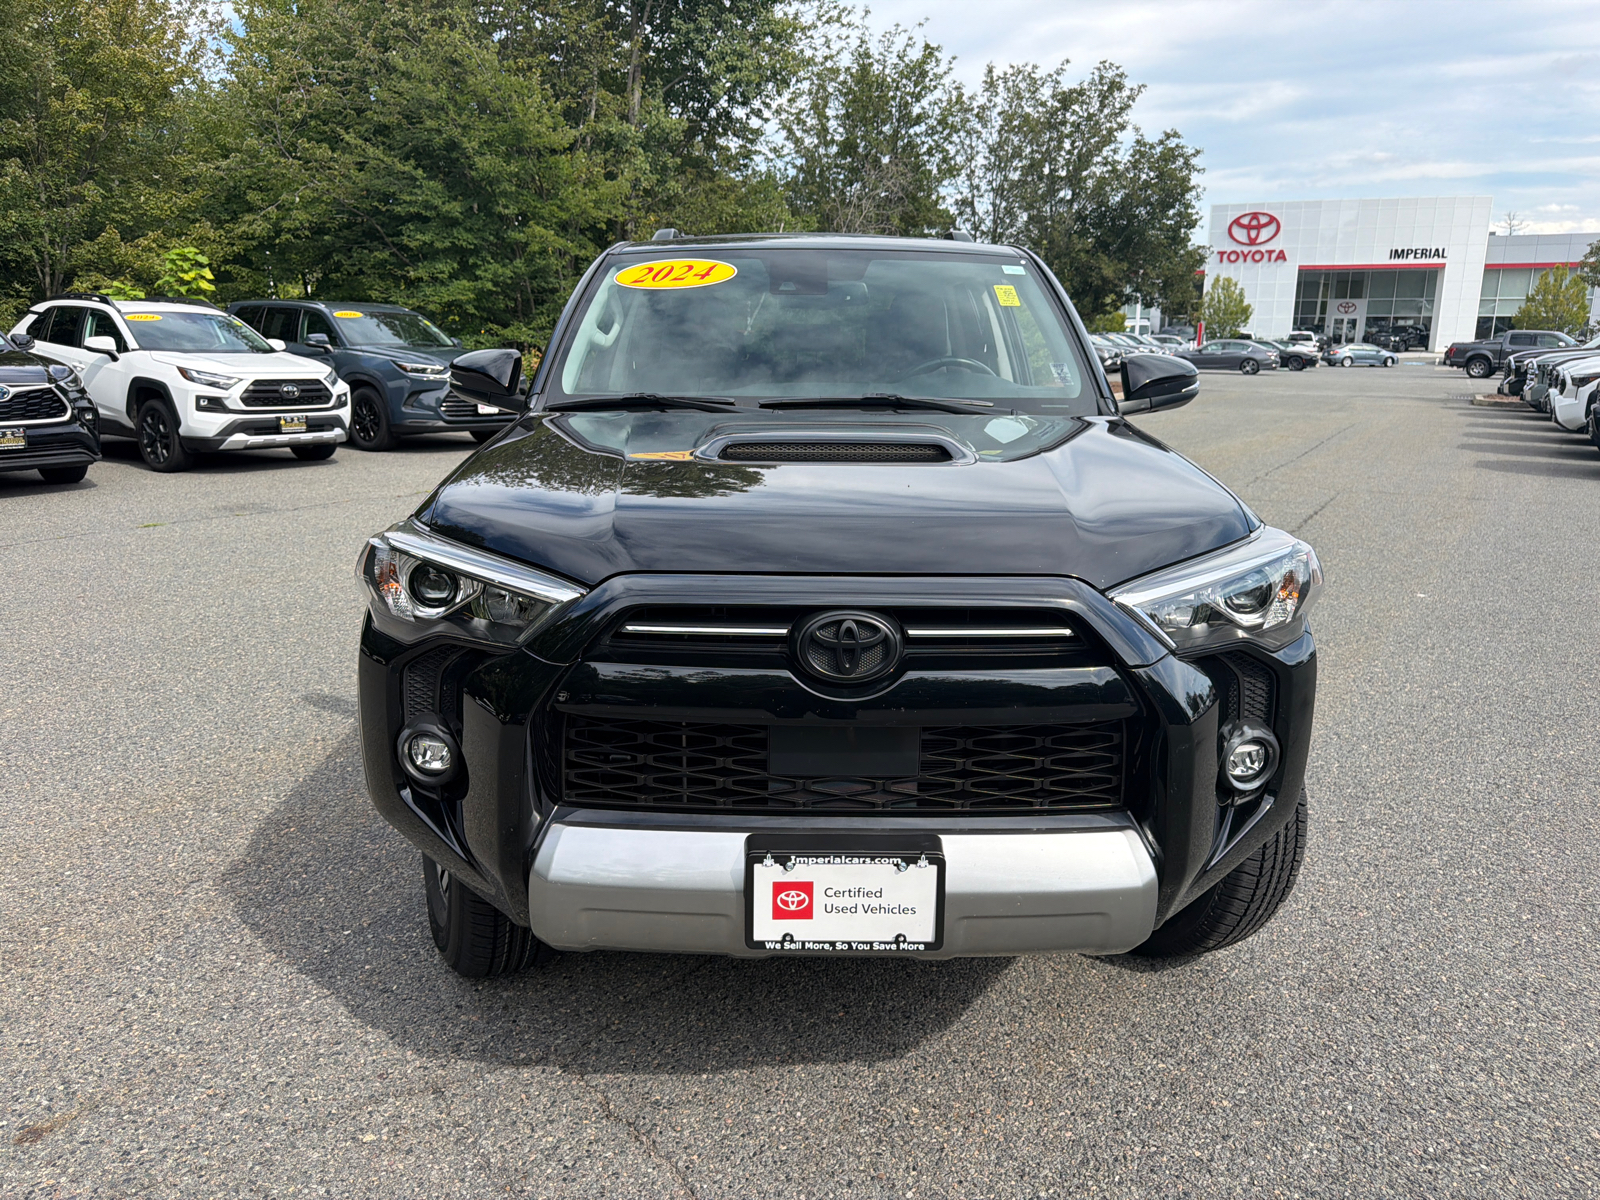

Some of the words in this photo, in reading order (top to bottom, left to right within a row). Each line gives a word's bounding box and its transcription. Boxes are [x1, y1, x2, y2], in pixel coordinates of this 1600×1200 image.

[1217, 249, 1287, 264] TOYOTA
[1389, 247, 1447, 260] IMPERIAL
[629, 264, 718, 284] 2024
[790, 855, 902, 865] Imperialcars.com
[824, 886, 883, 899] Certified
[824, 903, 858, 914] Used
[861, 903, 917, 915] Vehicles
[765, 941, 782, 950] We
[783, 941, 802, 950] Sell
[804, 941, 833, 951] More,
[835, 941, 849, 950] So
[851, 941, 870, 950] You
[872, 941, 897, 950] Save
[899, 941, 925, 951] More
